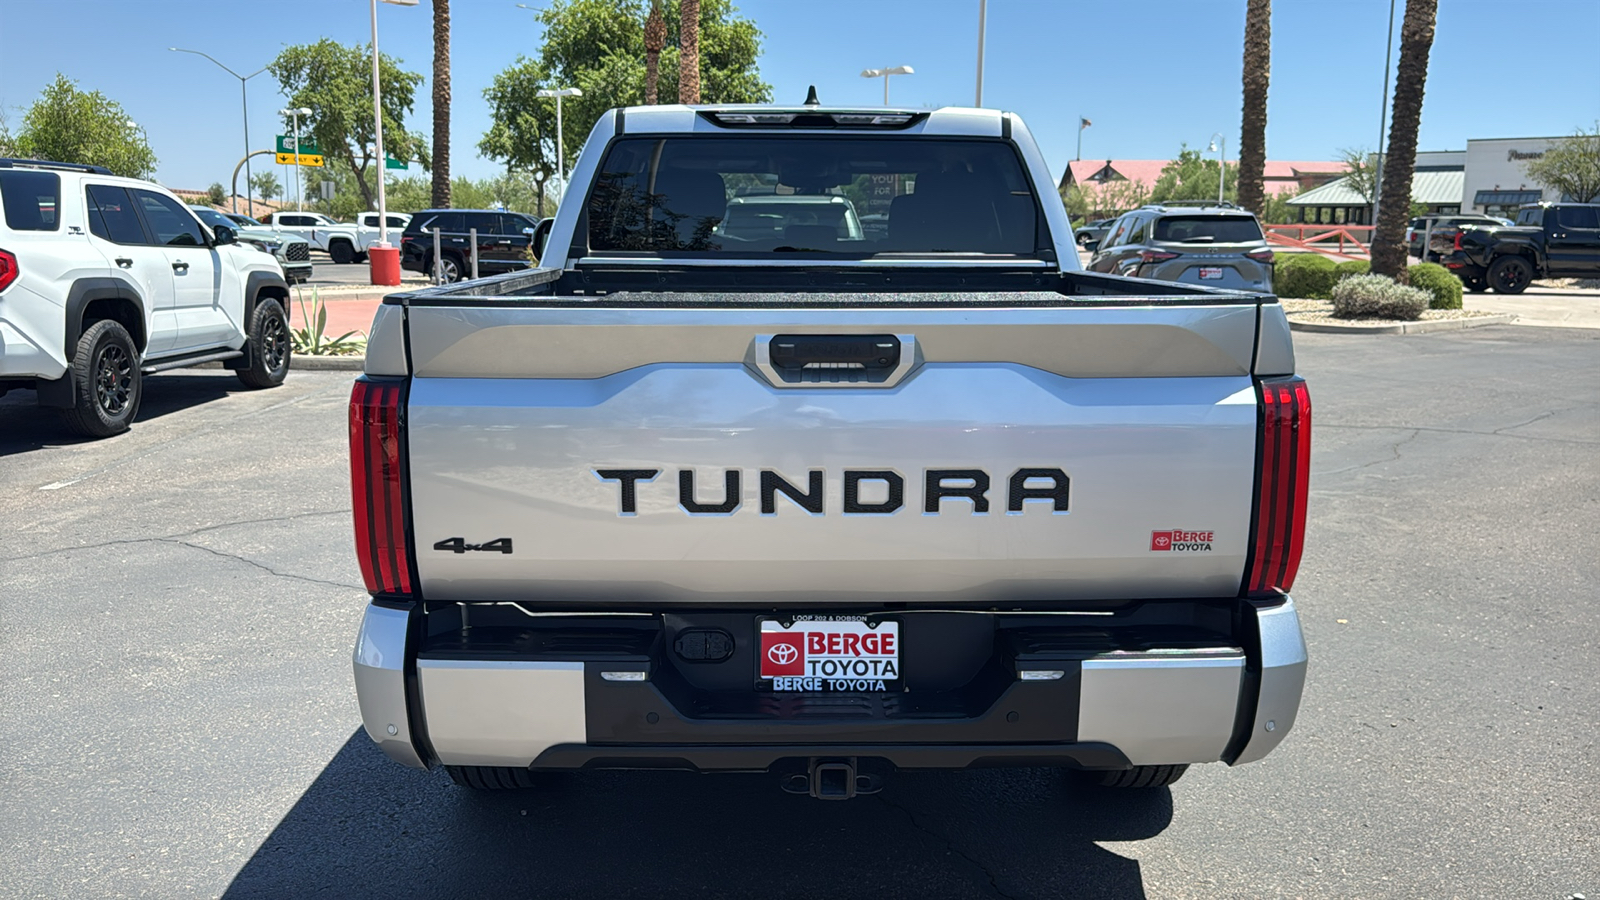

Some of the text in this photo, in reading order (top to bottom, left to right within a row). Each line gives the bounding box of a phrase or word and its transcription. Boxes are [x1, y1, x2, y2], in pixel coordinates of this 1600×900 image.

[872, 175, 893, 183] YOU
[592, 468, 1071, 516] TUNDRA
[1172, 530, 1214, 542] BERGE
[1172, 543, 1212, 551] TOYOTA
[807, 632, 896, 657] BERGE
[807, 660, 897, 676] TOYOTA
[773, 676, 887, 691] BERGE TOYOTA
